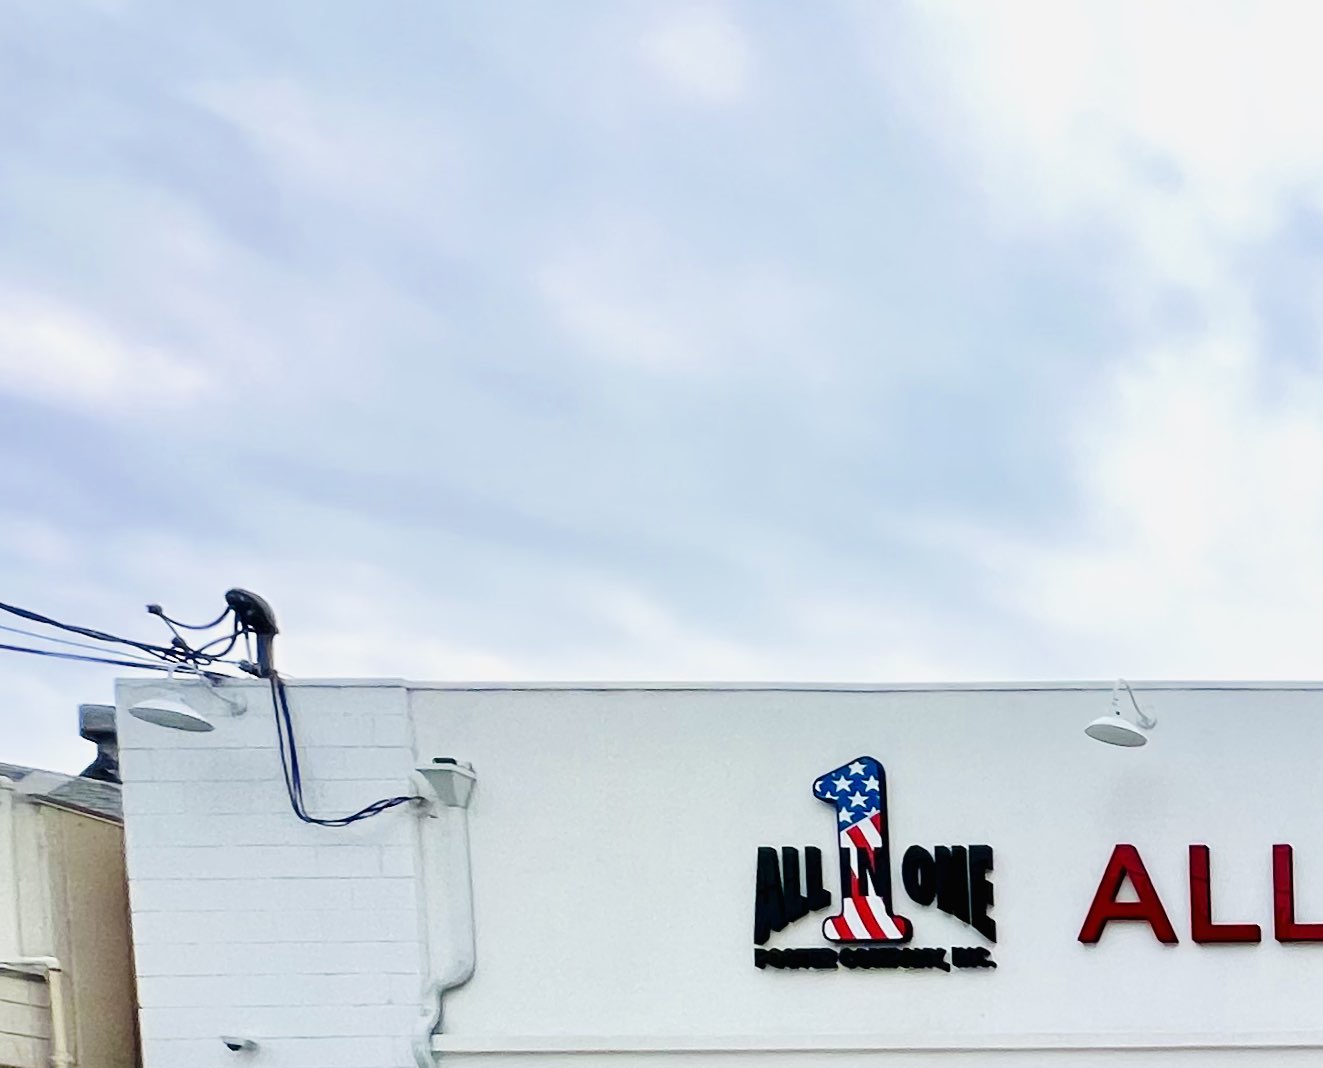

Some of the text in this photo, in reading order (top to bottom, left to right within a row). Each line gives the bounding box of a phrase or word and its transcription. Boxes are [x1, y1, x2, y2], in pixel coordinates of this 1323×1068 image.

[754, 845, 997, 945] ALL IN ONE
